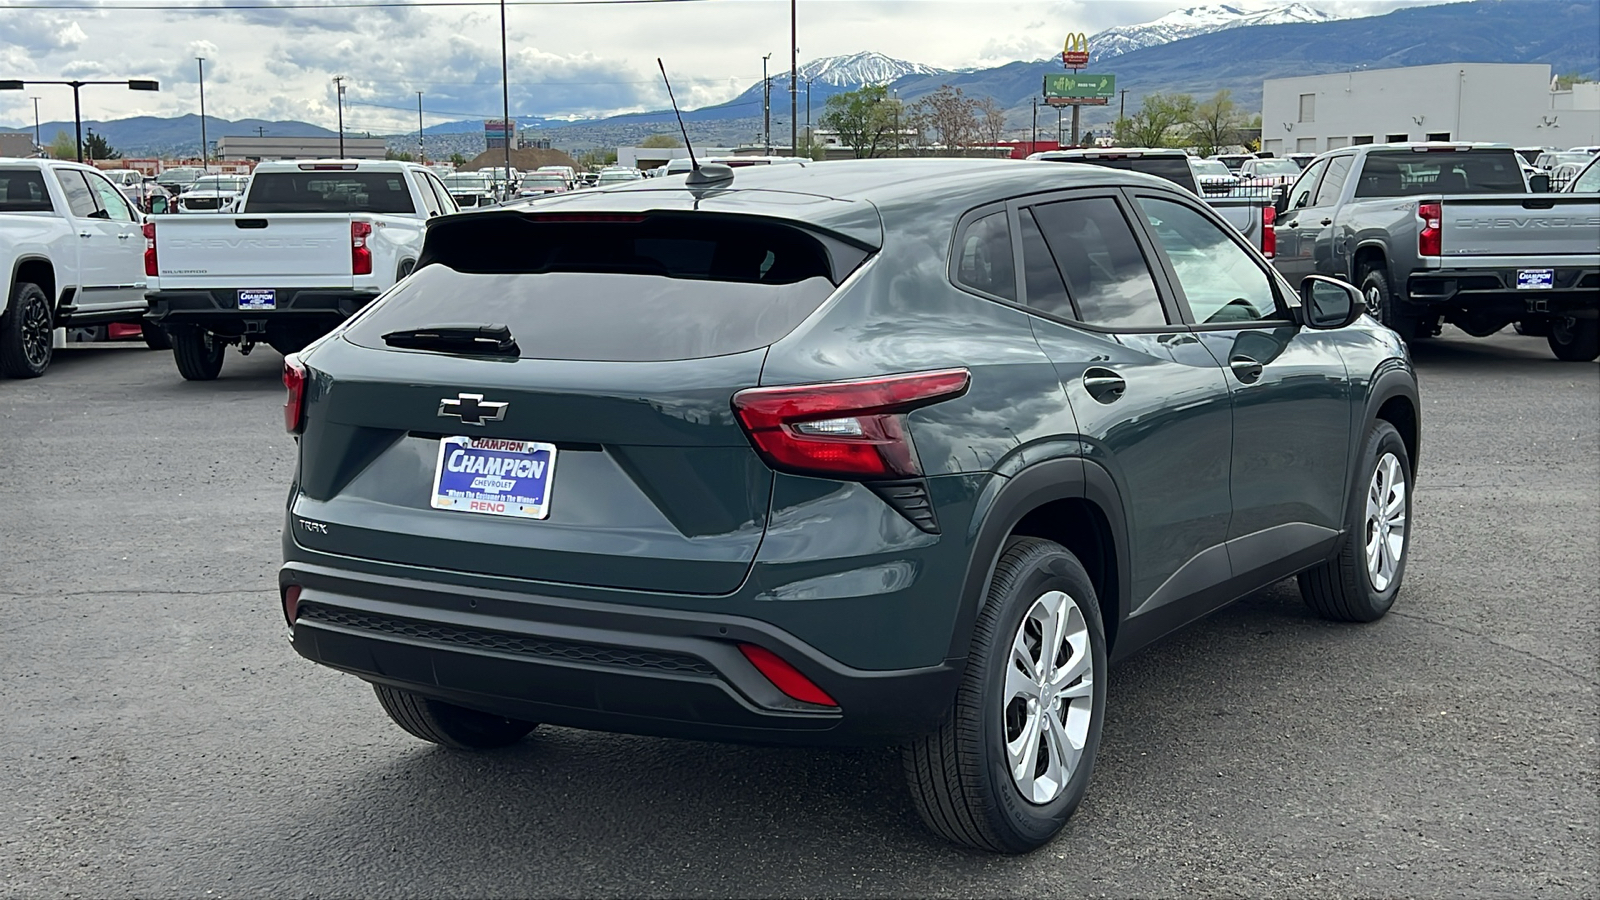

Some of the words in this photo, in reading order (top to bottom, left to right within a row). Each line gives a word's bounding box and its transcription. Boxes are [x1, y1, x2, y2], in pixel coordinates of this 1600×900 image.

[168, 238, 338, 249] CHEVROLET
[1519, 272, 1551, 280] CHAMPION
[240, 292, 273, 300] CHAMPION
[471, 439, 524, 452] CHAMPION
[447, 449, 545, 479] CHAMPION
[474, 477, 512, 488] CHEVROLET
[466, 490, 475, 498] The
[476, 492, 500, 501] Customer
[506, 494, 516, 502] The
[470, 501, 505, 513] RENO
[299, 519, 328, 535] TRAX
